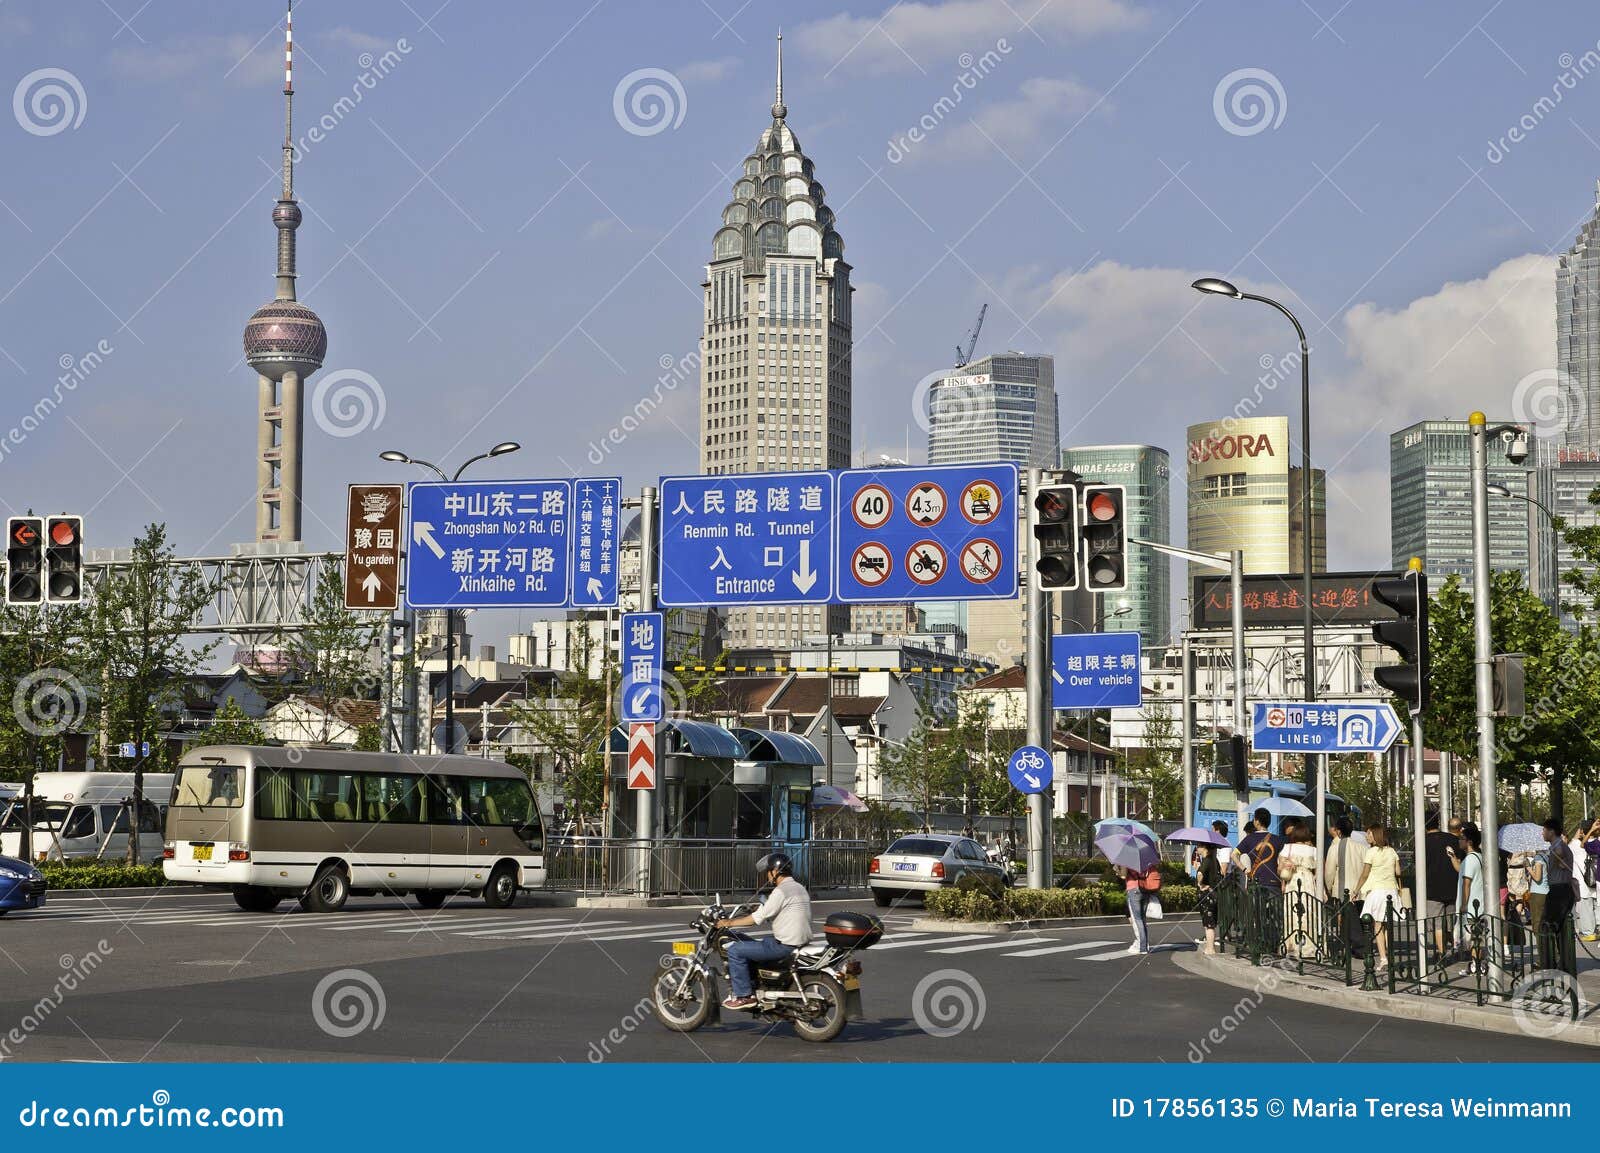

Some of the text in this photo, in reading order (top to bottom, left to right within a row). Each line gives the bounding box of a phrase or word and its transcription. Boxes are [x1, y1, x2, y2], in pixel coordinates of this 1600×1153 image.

[1072, 462, 1135, 474] MIRAE ASSET
[444, 489, 566, 517] 中山东二路
[671, 485, 823, 516] 人民路隧道
[862, 496, 884, 516] 40
[912, 496, 941, 514] 4.3m
[444, 520, 499, 538] Zhongshan
[503, 521, 517, 534] No
[529, 520, 546, 533] Rd.
[550, 519, 565, 537] (E)
[684, 520, 815, 539] Renmin Rd. Tunnel
[354, 528, 394, 549] 豫园
[353, 553, 394, 568] Yu garden
[451, 546, 555, 573] 新开河路
[708, 545, 784, 571] 入口
[460, 574, 548, 592] Xinkaihe Rd.
[716, 575, 776, 594] Entrance
[630, 619, 655, 684] 地面
[1067, 654, 1136, 671] 超限车辆
[1070, 674, 1133, 686] Over vehicle
